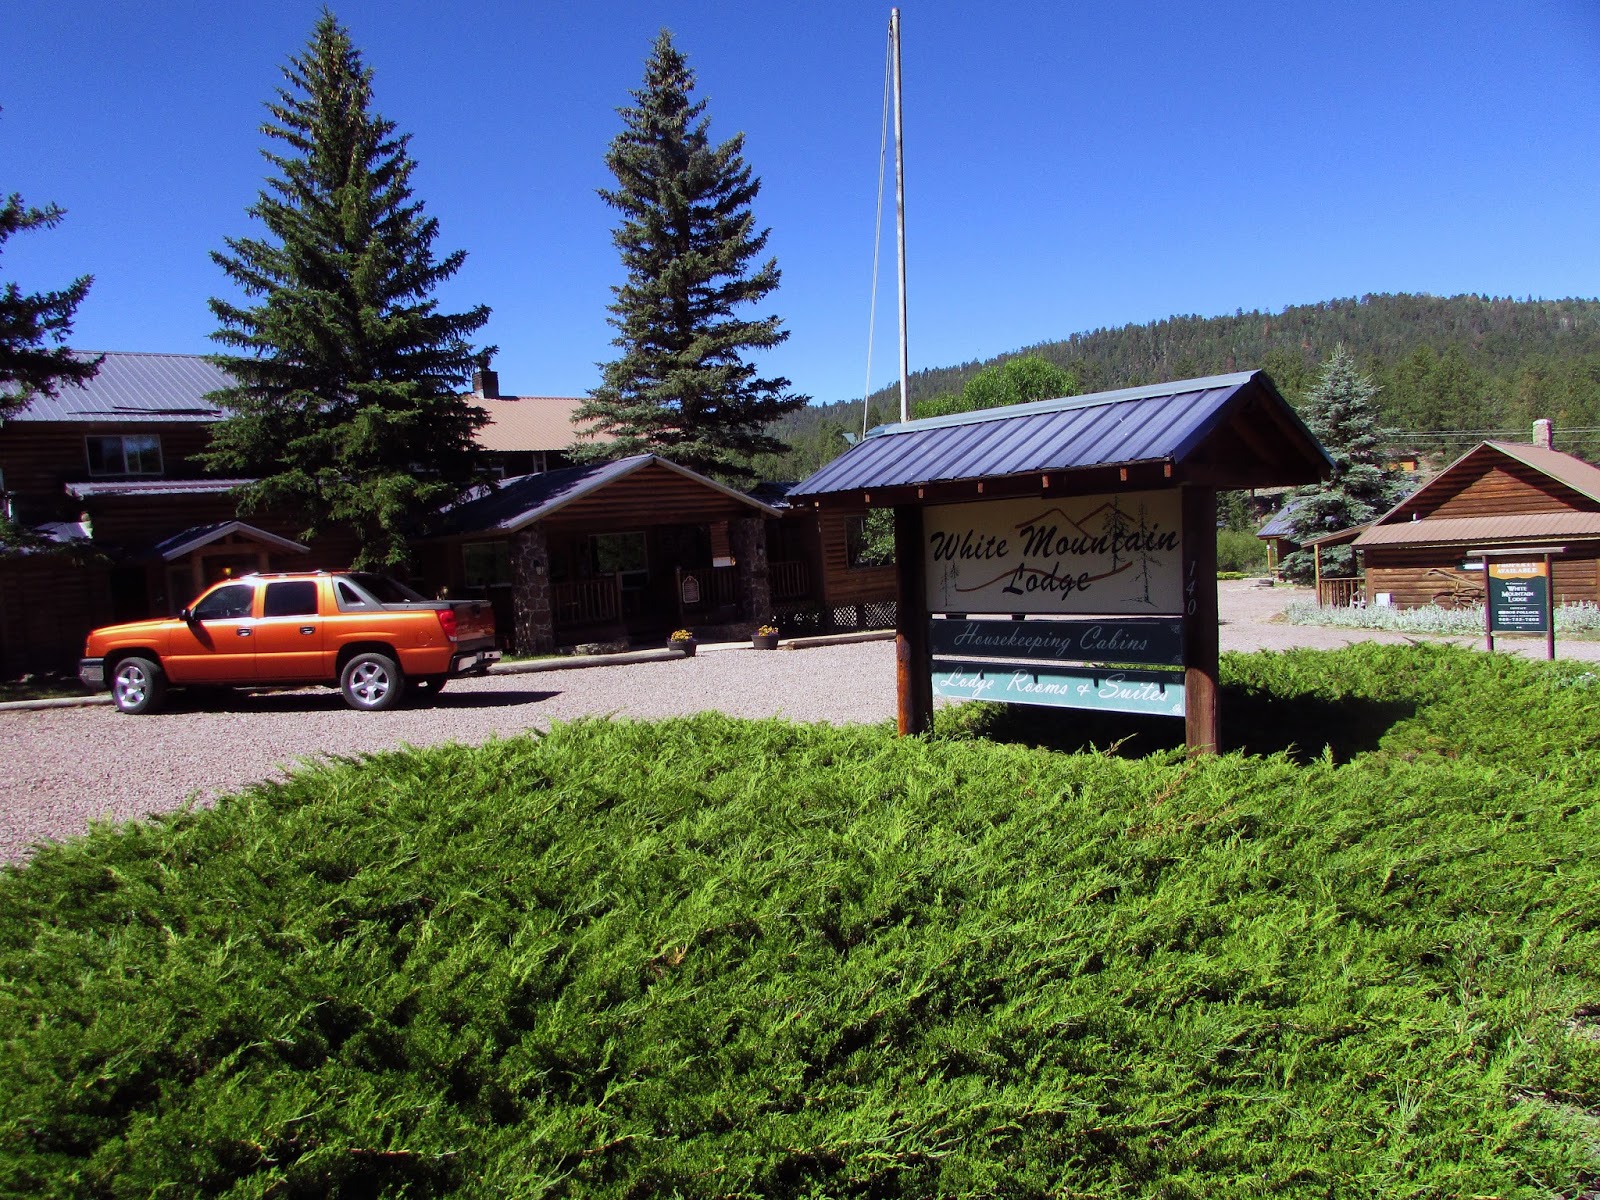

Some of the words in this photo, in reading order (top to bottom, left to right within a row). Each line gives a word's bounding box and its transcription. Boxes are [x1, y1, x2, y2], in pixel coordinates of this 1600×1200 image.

[930, 529, 1009, 562] White
[1019, 522, 1180, 559] Mountain
[1002, 561, 1092, 601] Lodge
[1186, 560, 1197, 616] 140
[953, 622, 1072, 656] Housekeeping
[1079, 625, 1149, 651] Cabins
[939, 666, 994, 698] Lodge
[1006, 669, 1069, 695] Rooms
[1097, 672, 1169, 701] Suites
